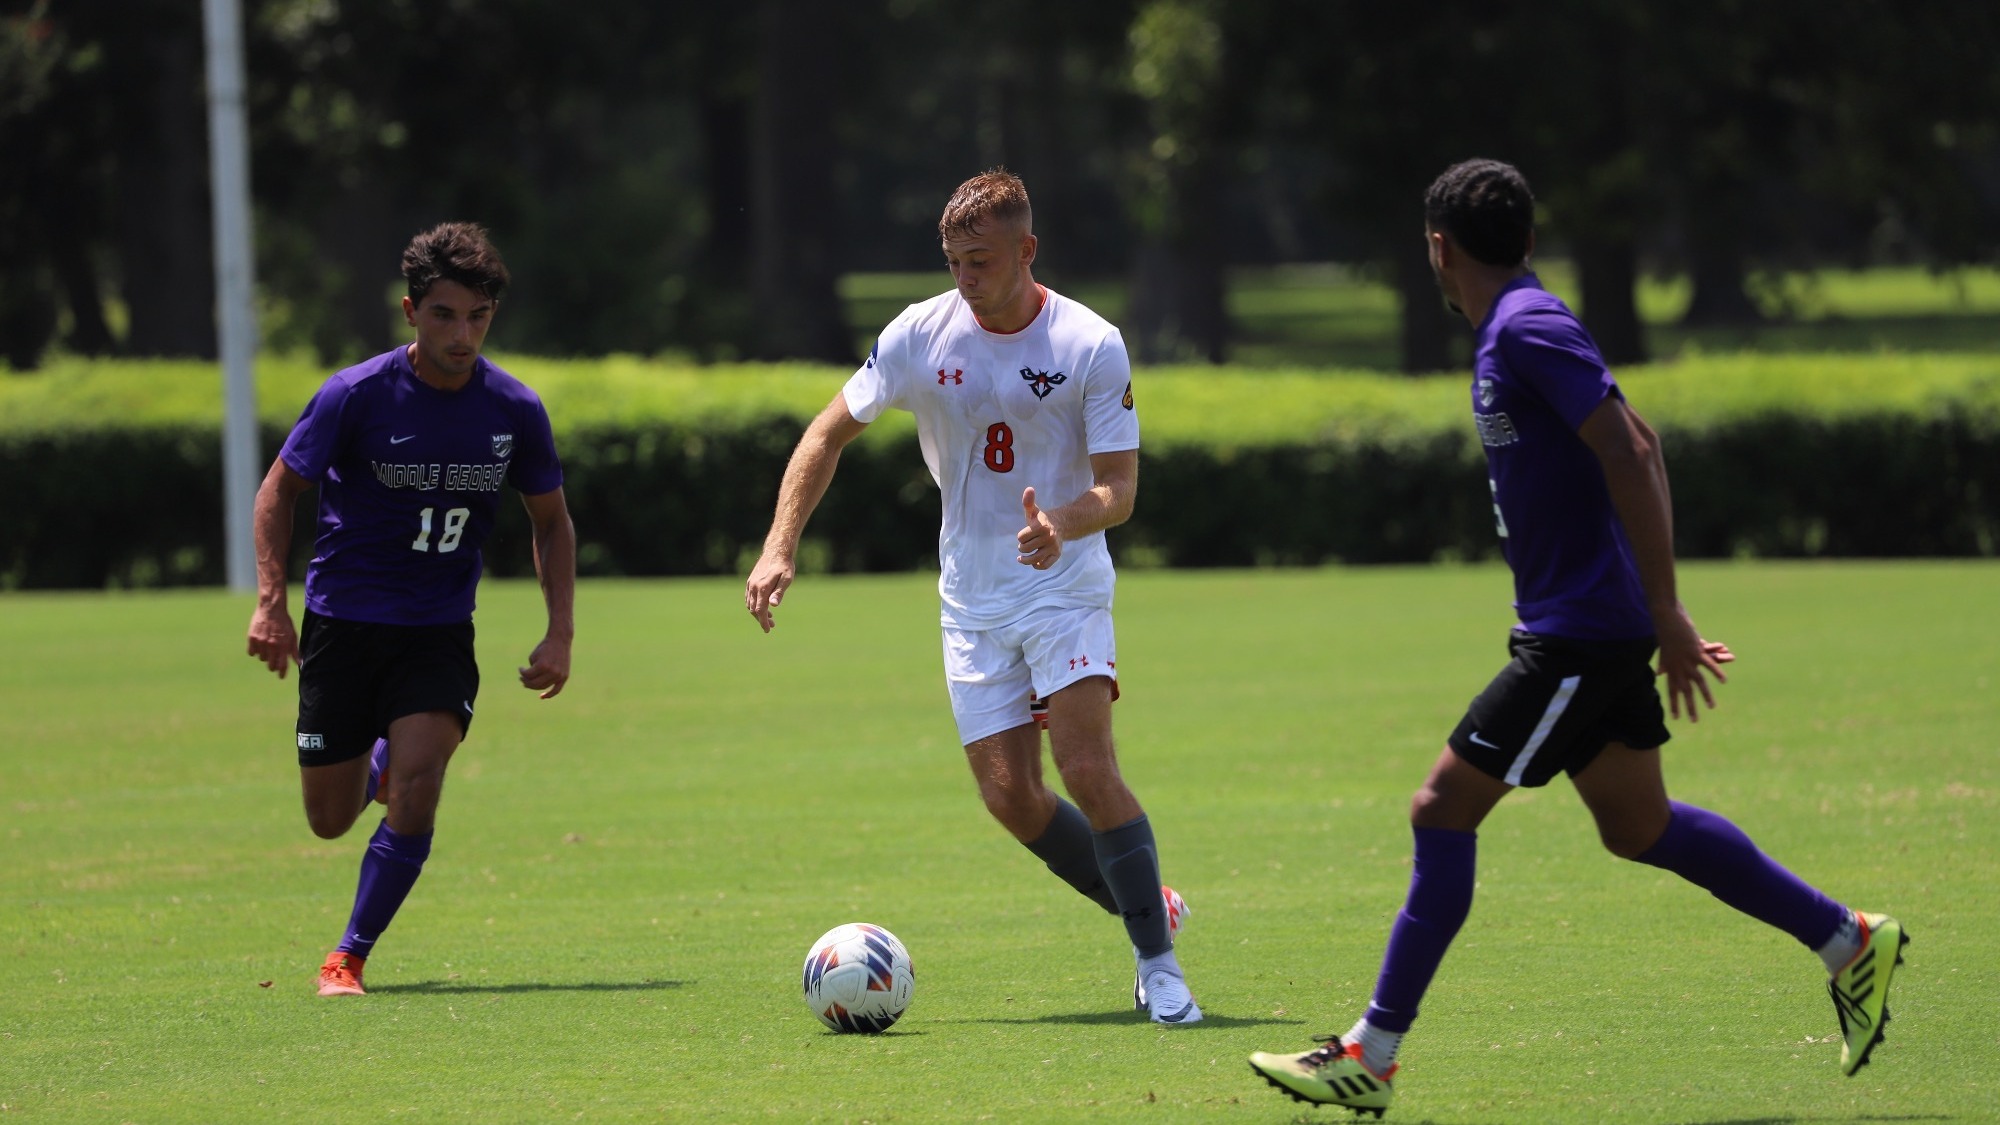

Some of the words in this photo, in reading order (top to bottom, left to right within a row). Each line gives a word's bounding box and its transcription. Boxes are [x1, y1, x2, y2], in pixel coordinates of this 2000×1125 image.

[984, 421, 1015, 473] 8
[372, 460, 441, 491] MIDDLE
[412, 507, 470, 553] 18
